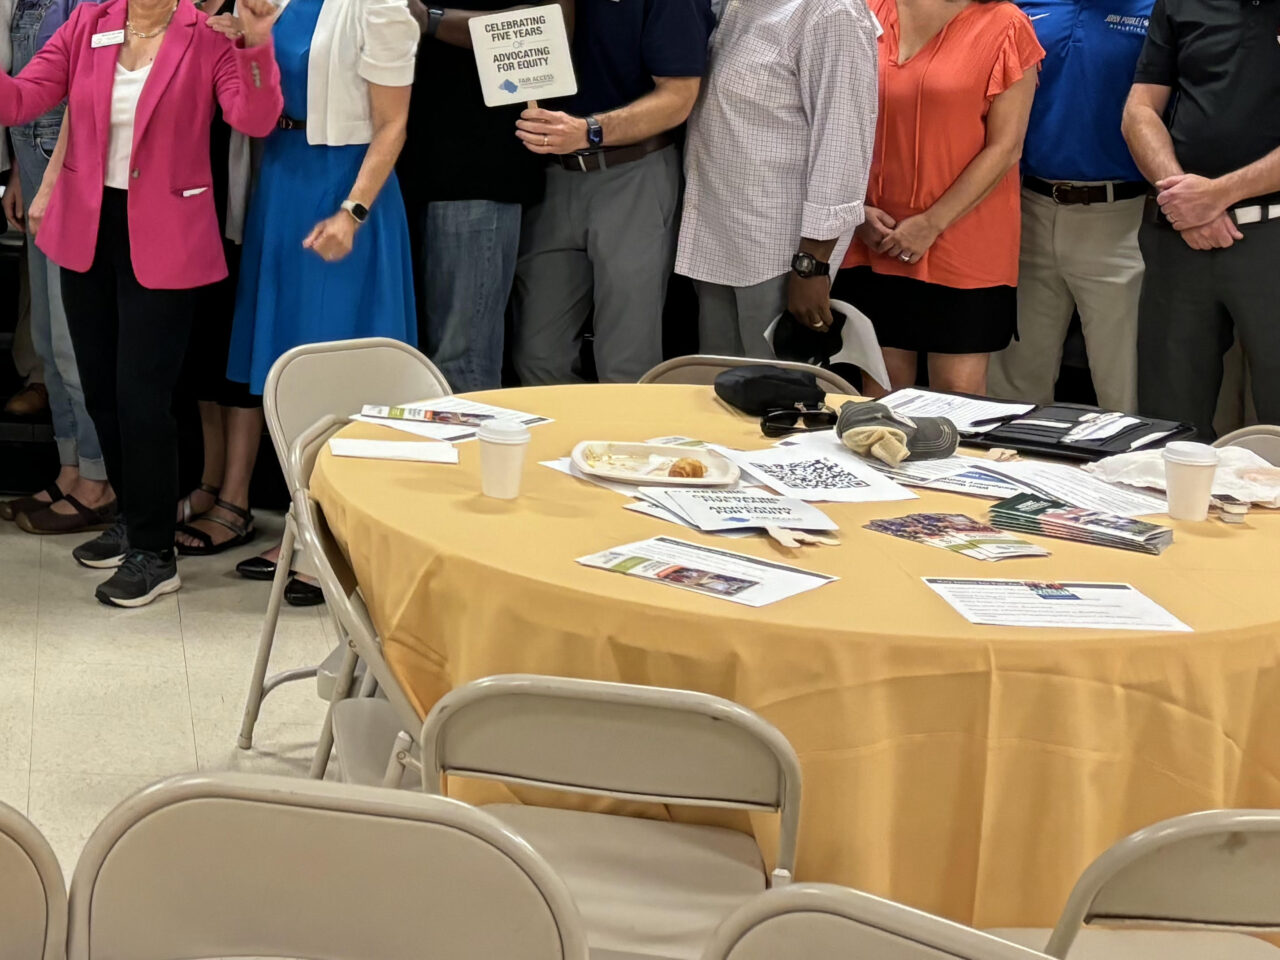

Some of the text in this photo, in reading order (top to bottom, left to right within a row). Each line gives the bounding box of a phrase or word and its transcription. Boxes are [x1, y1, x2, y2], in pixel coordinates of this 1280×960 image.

[485, 15, 546, 33] CELEBRATING
[491, 26, 543, 42] FIVE YEARS
[493, 46, 551, 64] ADVOCATING
[497, 57, 549, 73] FOR EQUITY
